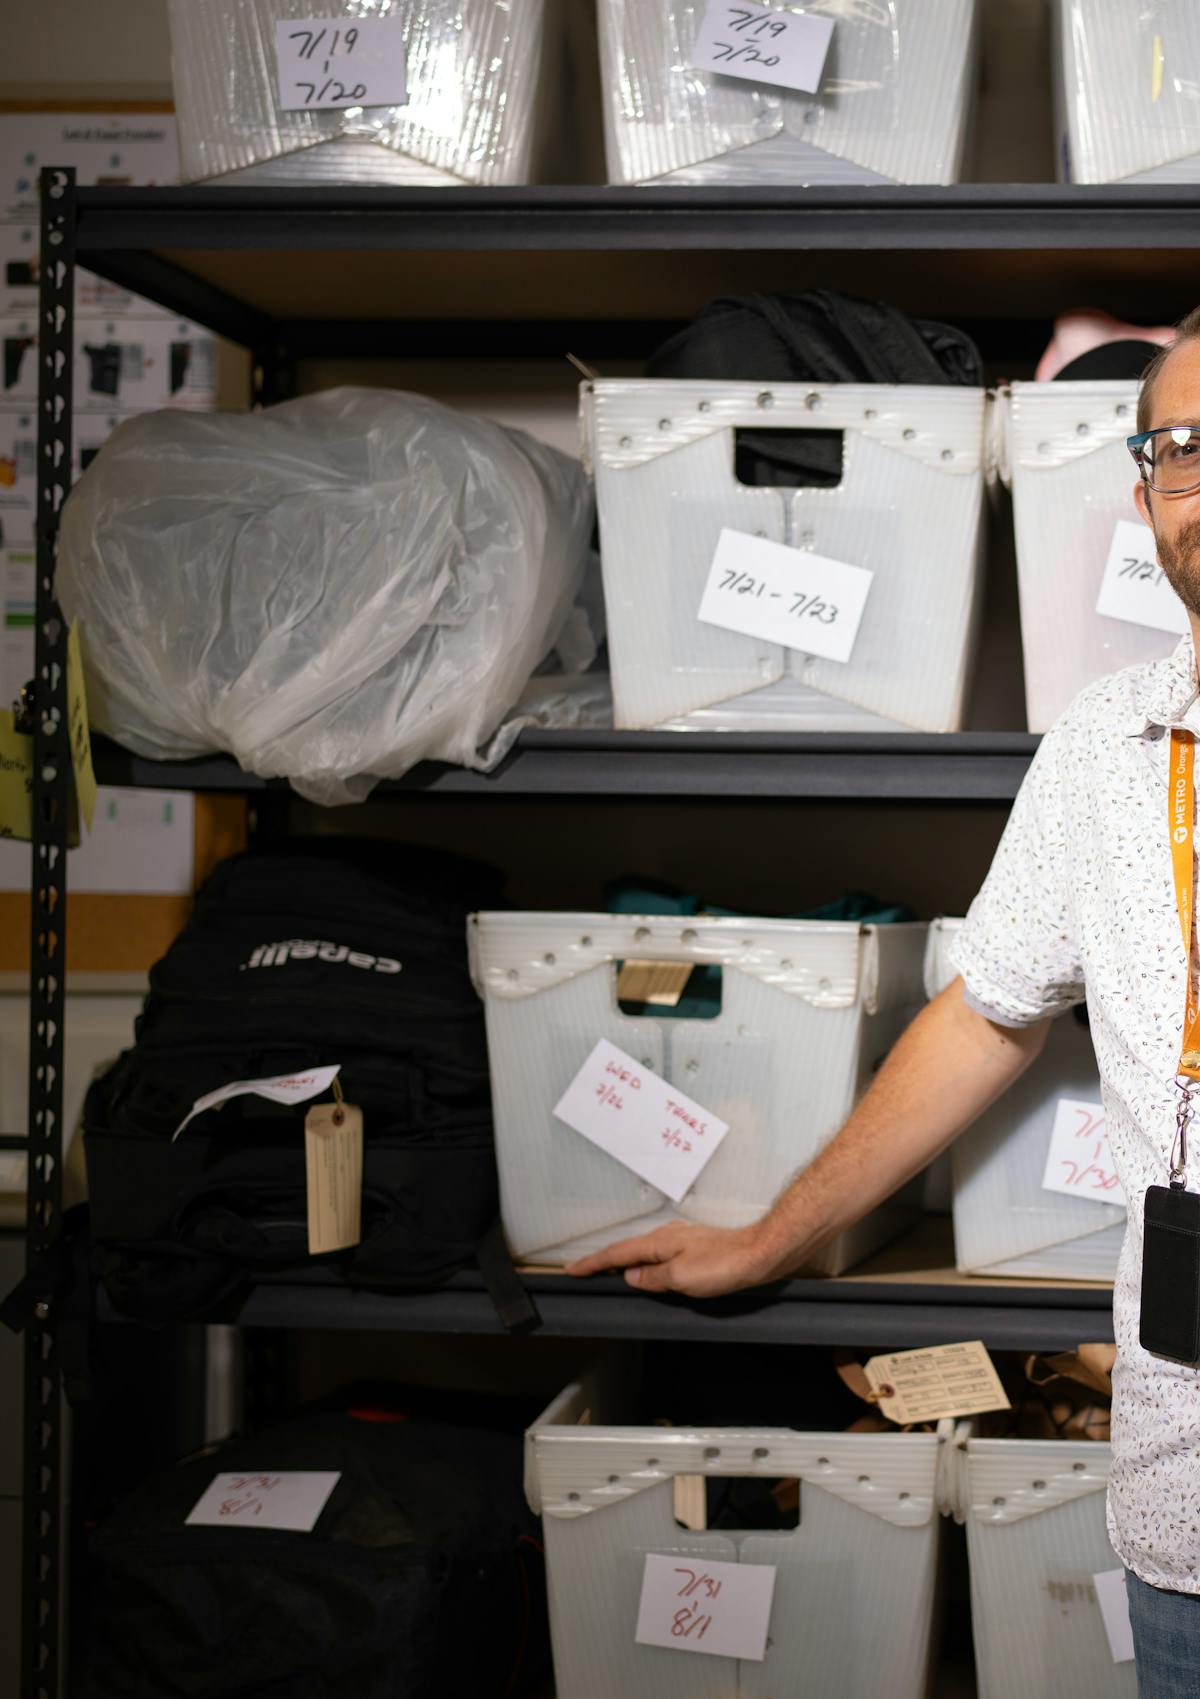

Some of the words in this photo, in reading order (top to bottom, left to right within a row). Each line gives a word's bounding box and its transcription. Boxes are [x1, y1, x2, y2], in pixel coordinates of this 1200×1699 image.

[728, 9, 788, 38] 7/19
[289, 28, 359, 59] 7/19
[712, 42, 781, 67] 7/20
[295, 78, 367, 104] 7/20
[1118, 558, 1164, 587] 7/21
[719, 569, 766, 598] 7/21
[788, 592, 839, 625] 7/23
[1176, 743, 1189, 775] Orange
[1175, 778, 1186, 825] METRO
[1060, 1161, 1119, 1190] 7/30
[674, 1567, 722, 1599] 7/31
[671, 1607, 712, 1639] 8/1
